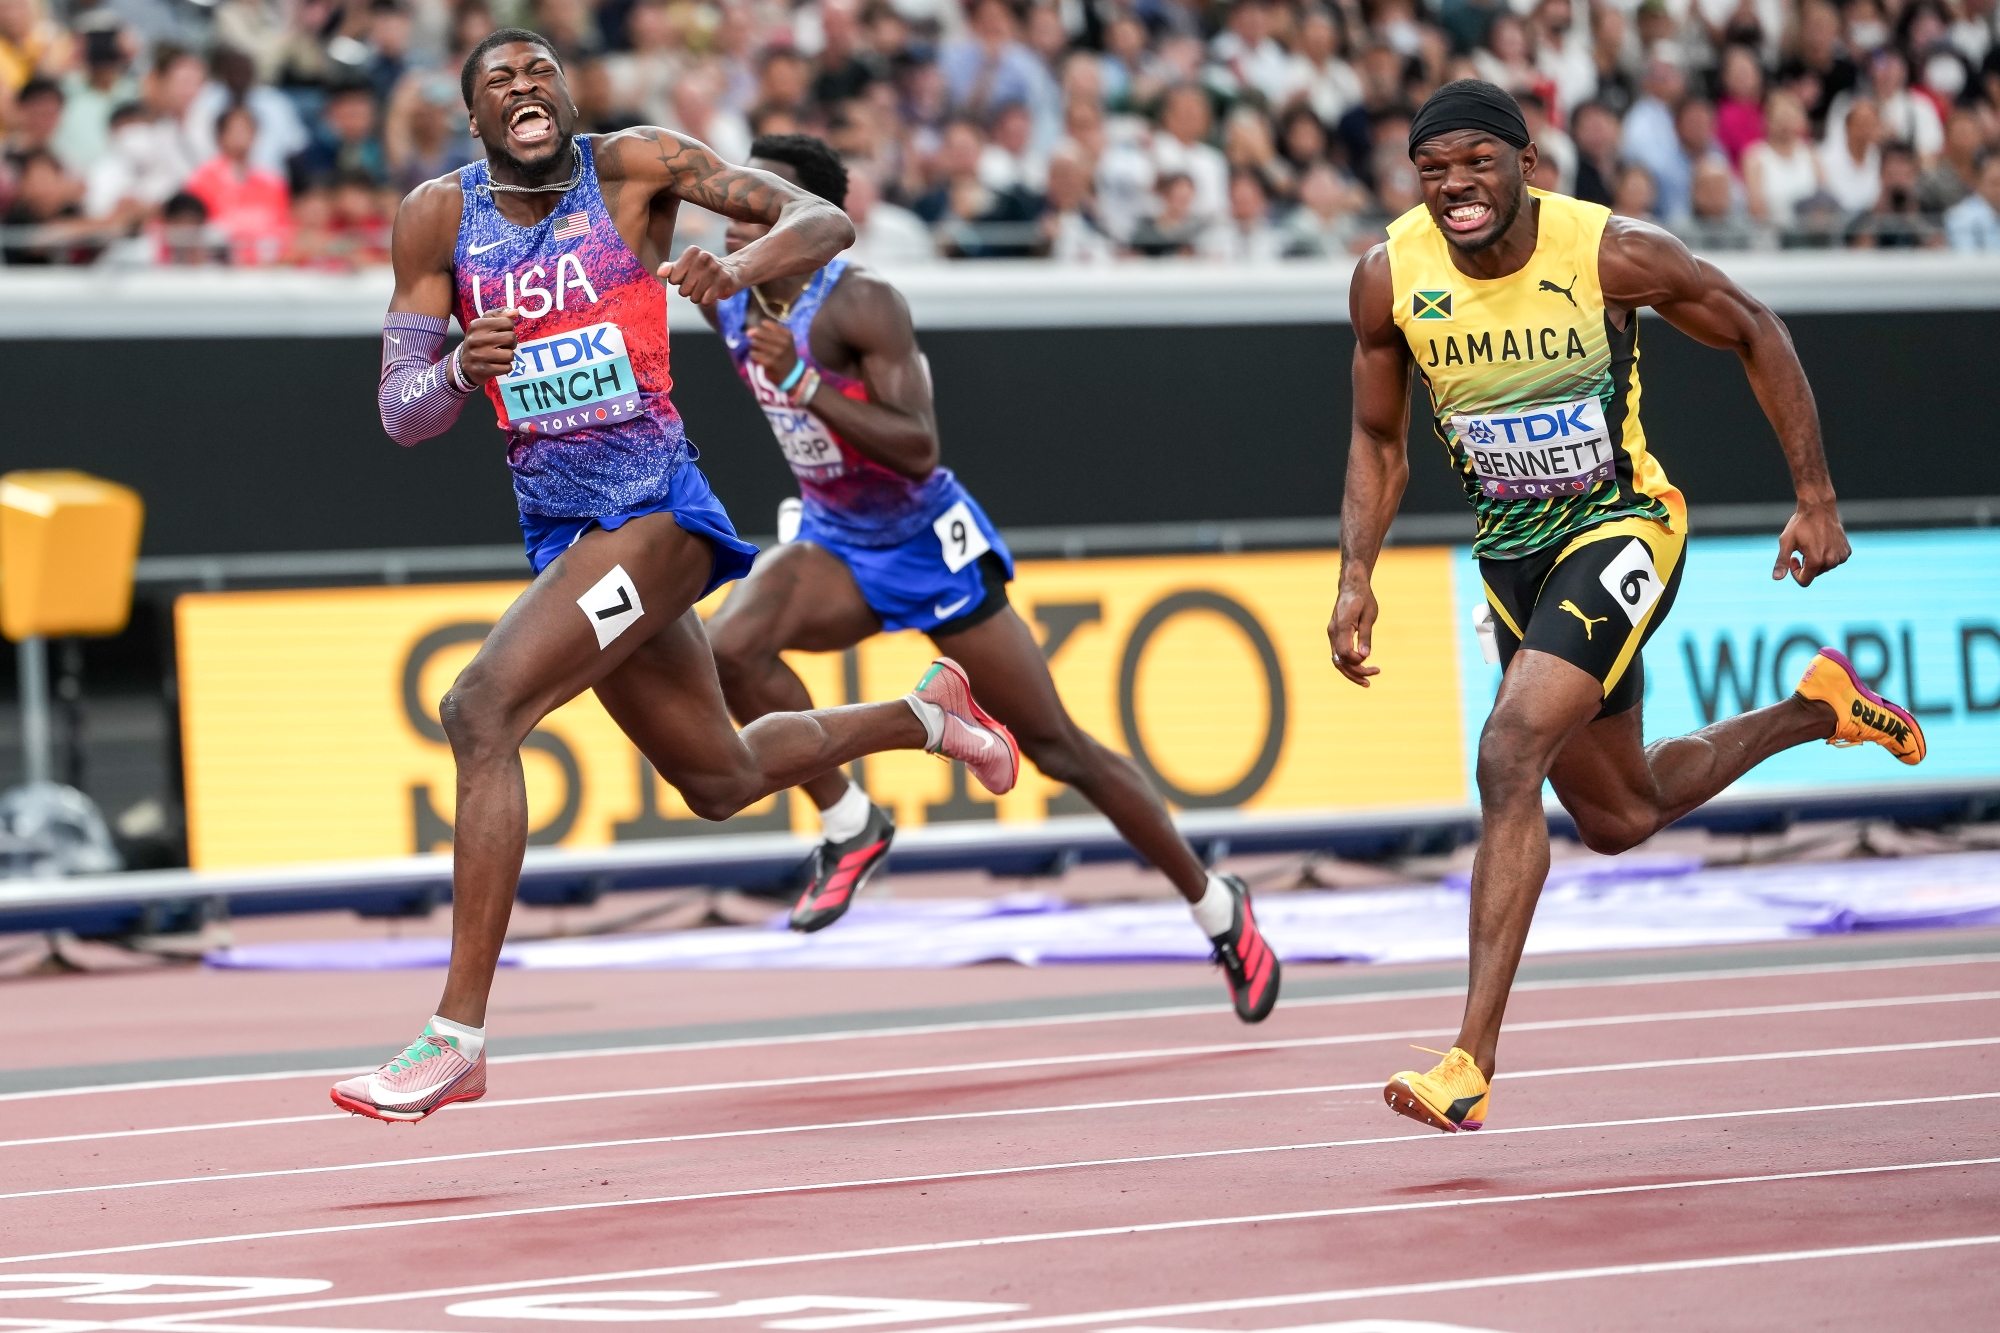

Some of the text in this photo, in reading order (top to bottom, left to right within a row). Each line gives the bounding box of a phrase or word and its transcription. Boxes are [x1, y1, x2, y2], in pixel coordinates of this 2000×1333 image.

[472, 253, 598, 319] USA
[520, 327, 614, 373] TDK
[1427, 327, 1587, 368] JAMAICA
[401, 363, 438, 402] USA
[510, 363, 622, 412] TINCH
[1491, 403, 1595, 443] TDK
[1473, 437, 1603, 481] BENNETT
[950, 520, 967, 556] 9
[594, 585, 633, 621] 7
[1619, 569, 1650, 606] 6
[1851, 699, 1912, 749] NITRO
